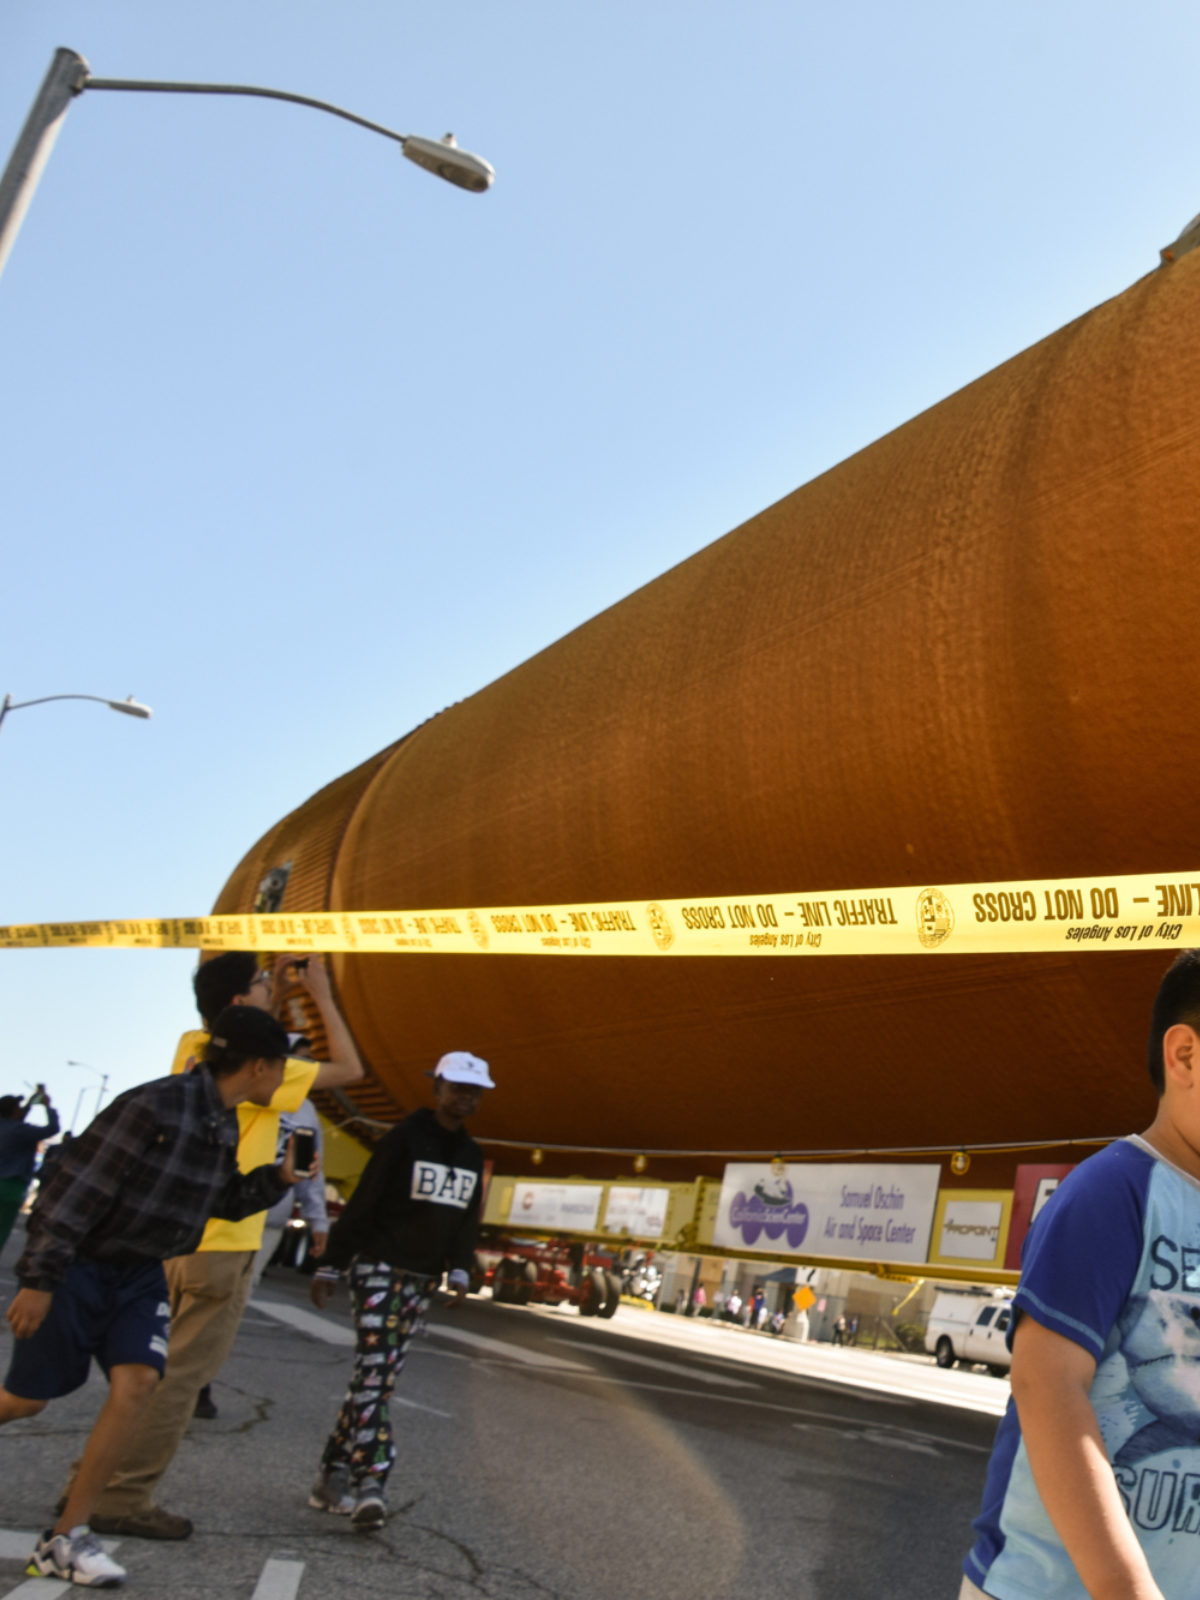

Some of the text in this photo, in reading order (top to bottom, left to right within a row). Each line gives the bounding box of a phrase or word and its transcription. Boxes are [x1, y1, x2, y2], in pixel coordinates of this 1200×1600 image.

[727, 904, 754, 928] NOT
[755, 904, 778, 928] DO
[797, 901, 832, 928] LINE
[836, 897, 898, 927] TRAFFIC
[973, 890, 1037, 923] CROSS
[1044, 888, 1083, 921] NOT
[1090, 886, 1119, 919] DO
[681, 906, 725, 930] CROSS
[1065, 922, 1183, 941] City of Los Angeles
[824, 1215, 917, 1246] Air and Space Center
